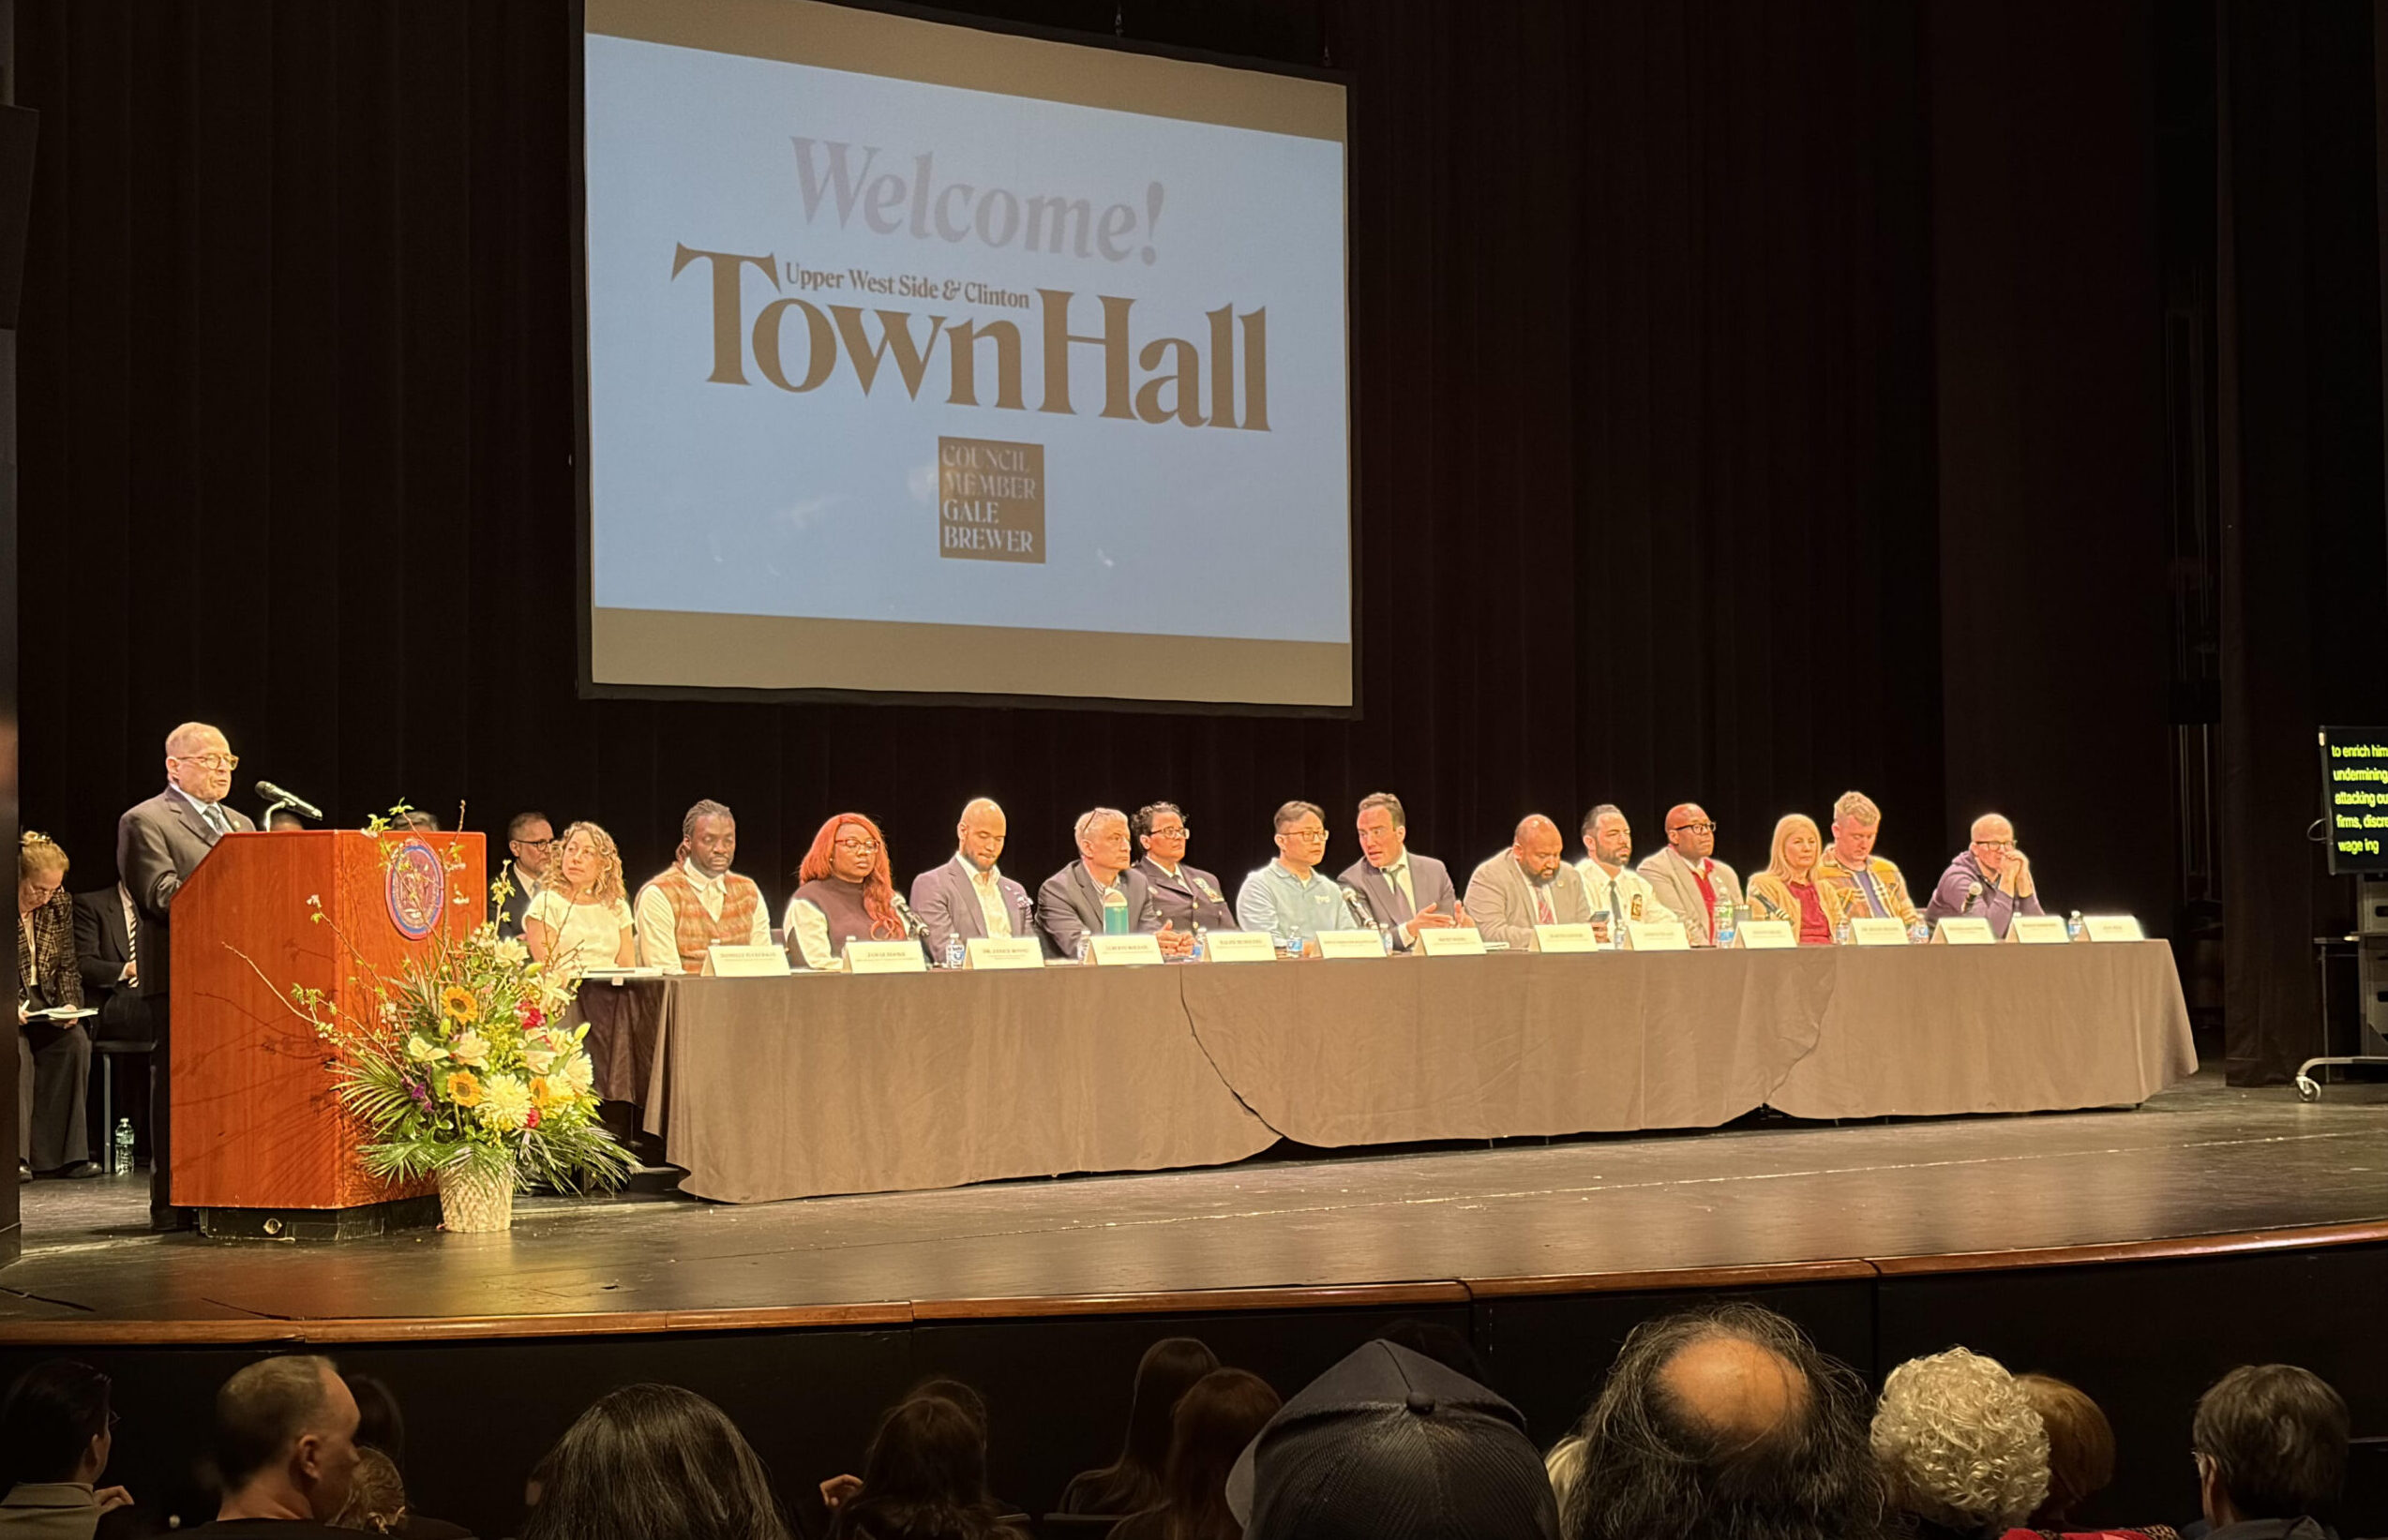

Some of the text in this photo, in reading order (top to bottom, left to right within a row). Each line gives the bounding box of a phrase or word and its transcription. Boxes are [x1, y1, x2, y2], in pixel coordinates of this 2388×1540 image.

[789, 136, 1164, 266] Welcome!
[785, 262, 1030, 308] Upper West Side & Clinton
[941, 444, 1029, 473] COUNCIL
[942, 470, 1036, 500] MEMBER
[943, 499, 999, 524] GALE
[944, 525, 1034, 552] BREWER
[2331, 744, 2342, 757] to
[2343, 744, 2370, 757] enrich
[2335, 791, 2376, 808] attacking
[2336, 814, 2363, 830] firms,
[2337, 838, 2380, 855] wage ing
